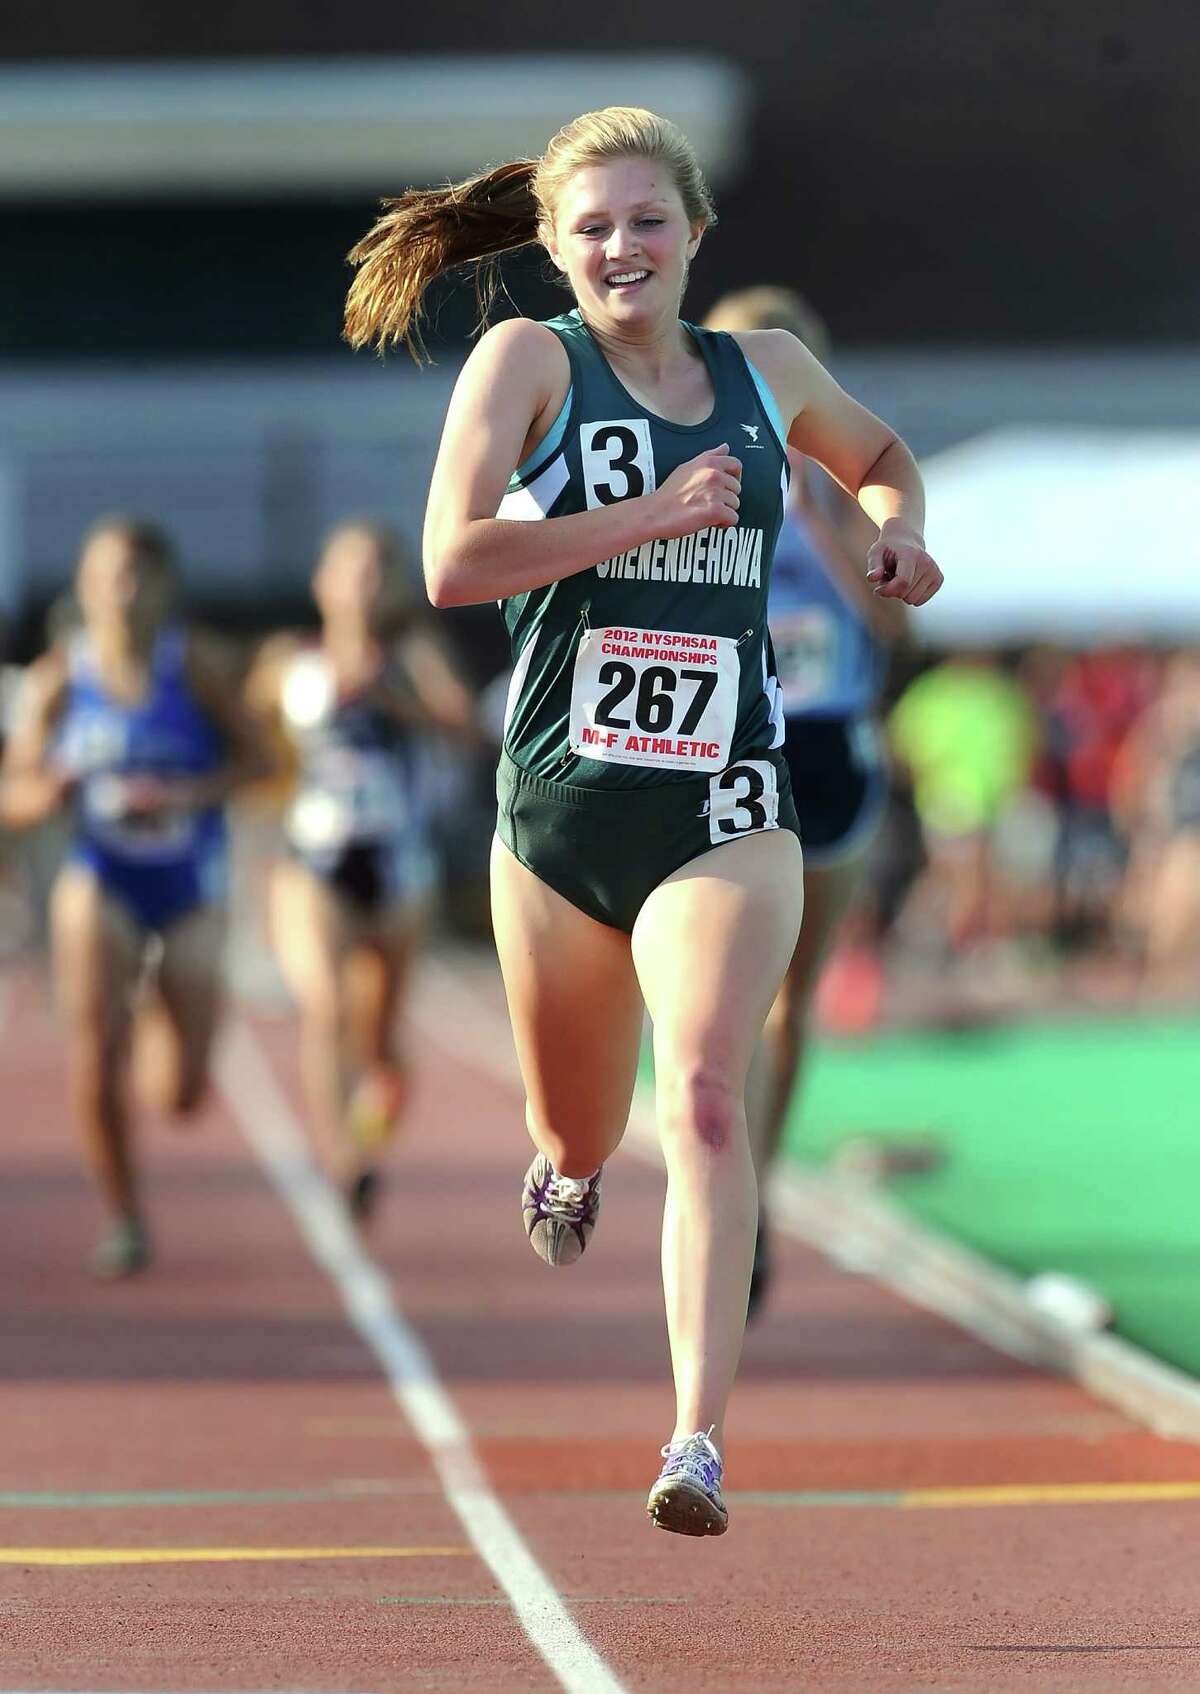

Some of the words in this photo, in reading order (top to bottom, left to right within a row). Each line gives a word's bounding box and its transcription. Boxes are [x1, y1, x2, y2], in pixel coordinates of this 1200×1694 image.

[591, 425, 645, 506] 3
[601, 643, 718, 665] CHAMPIONSHIPS
[603, 629, 638, 643] 2012
[642, 632, 718, 651] NYSPHSAA
[594, 661, 718, 736] 267
[582, 728, 618, 748] M-F
[625, 735, 720, 758] ATHLETIC
[718, 766, 767, 834] 3
